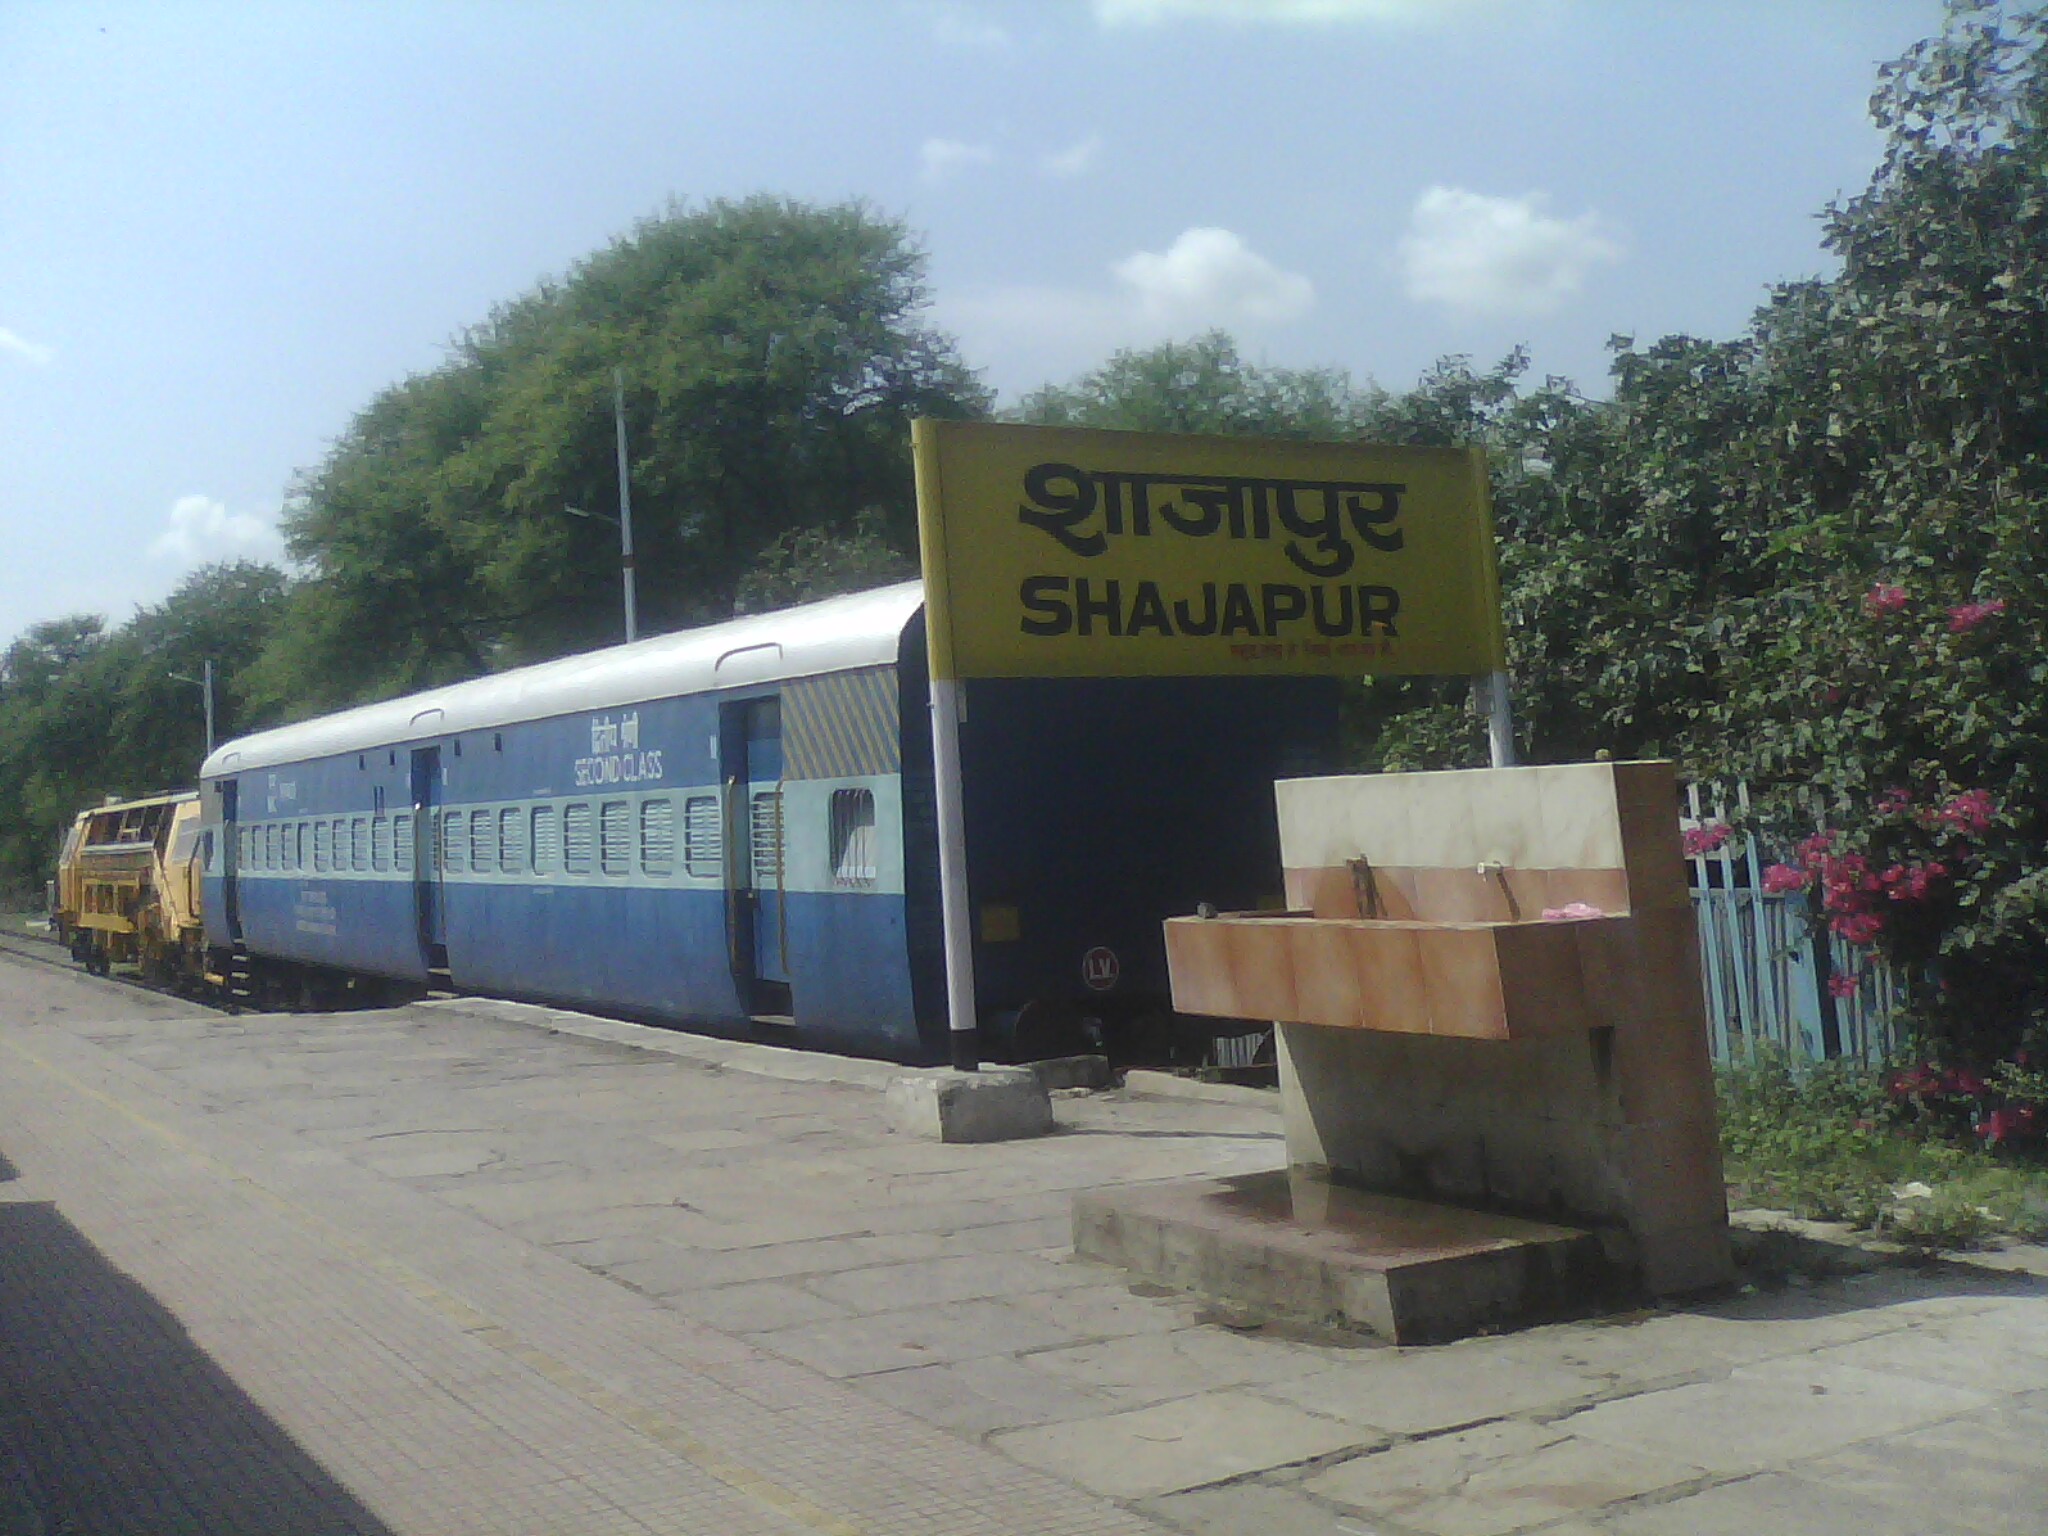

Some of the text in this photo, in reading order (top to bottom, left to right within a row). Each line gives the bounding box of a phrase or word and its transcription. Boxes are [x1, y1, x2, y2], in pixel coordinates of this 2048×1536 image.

[1018, 462, 1406, 578] शाजापुर
[1018, 575, 1400, 638] SHAJAPUR
[574, 750, 663, 787] SECOND CLASS
